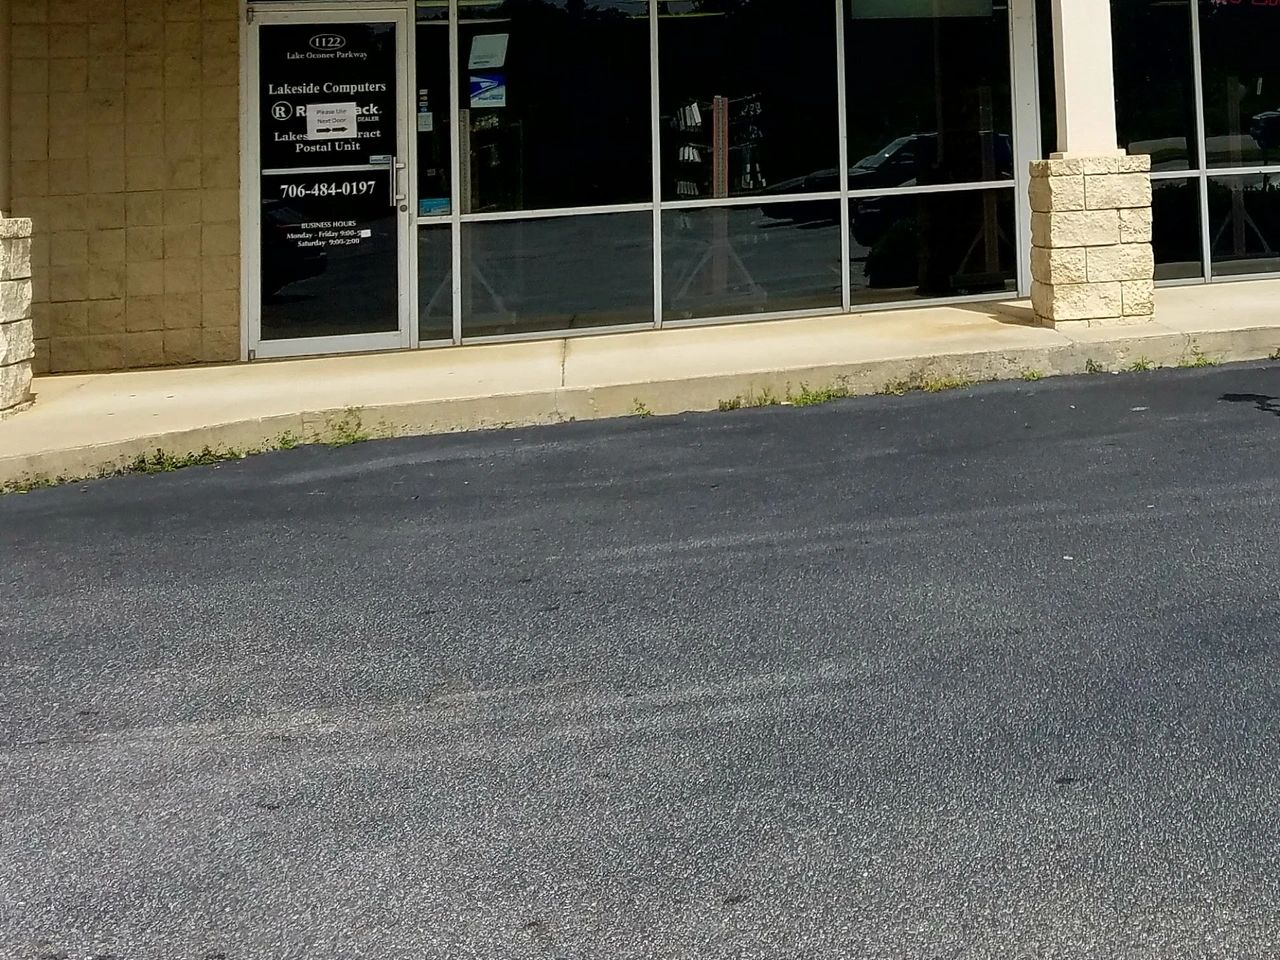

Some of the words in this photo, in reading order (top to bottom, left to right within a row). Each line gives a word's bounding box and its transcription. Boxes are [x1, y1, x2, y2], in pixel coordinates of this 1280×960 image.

[315, 37, 341, 47] 1122
[286, 52, 305, 60] Lake
[336, 51, 368, 61] Parkway
[268, 83, 320, 95] Lakeside
[323, 82, 386, 95] Computers
[274, 131, 309, 142] Lakes
[295, 143, 332, 153] Postal
[335, 142, 361, 151] Unit
[280, 180, 376, 199] 706-484-0197
